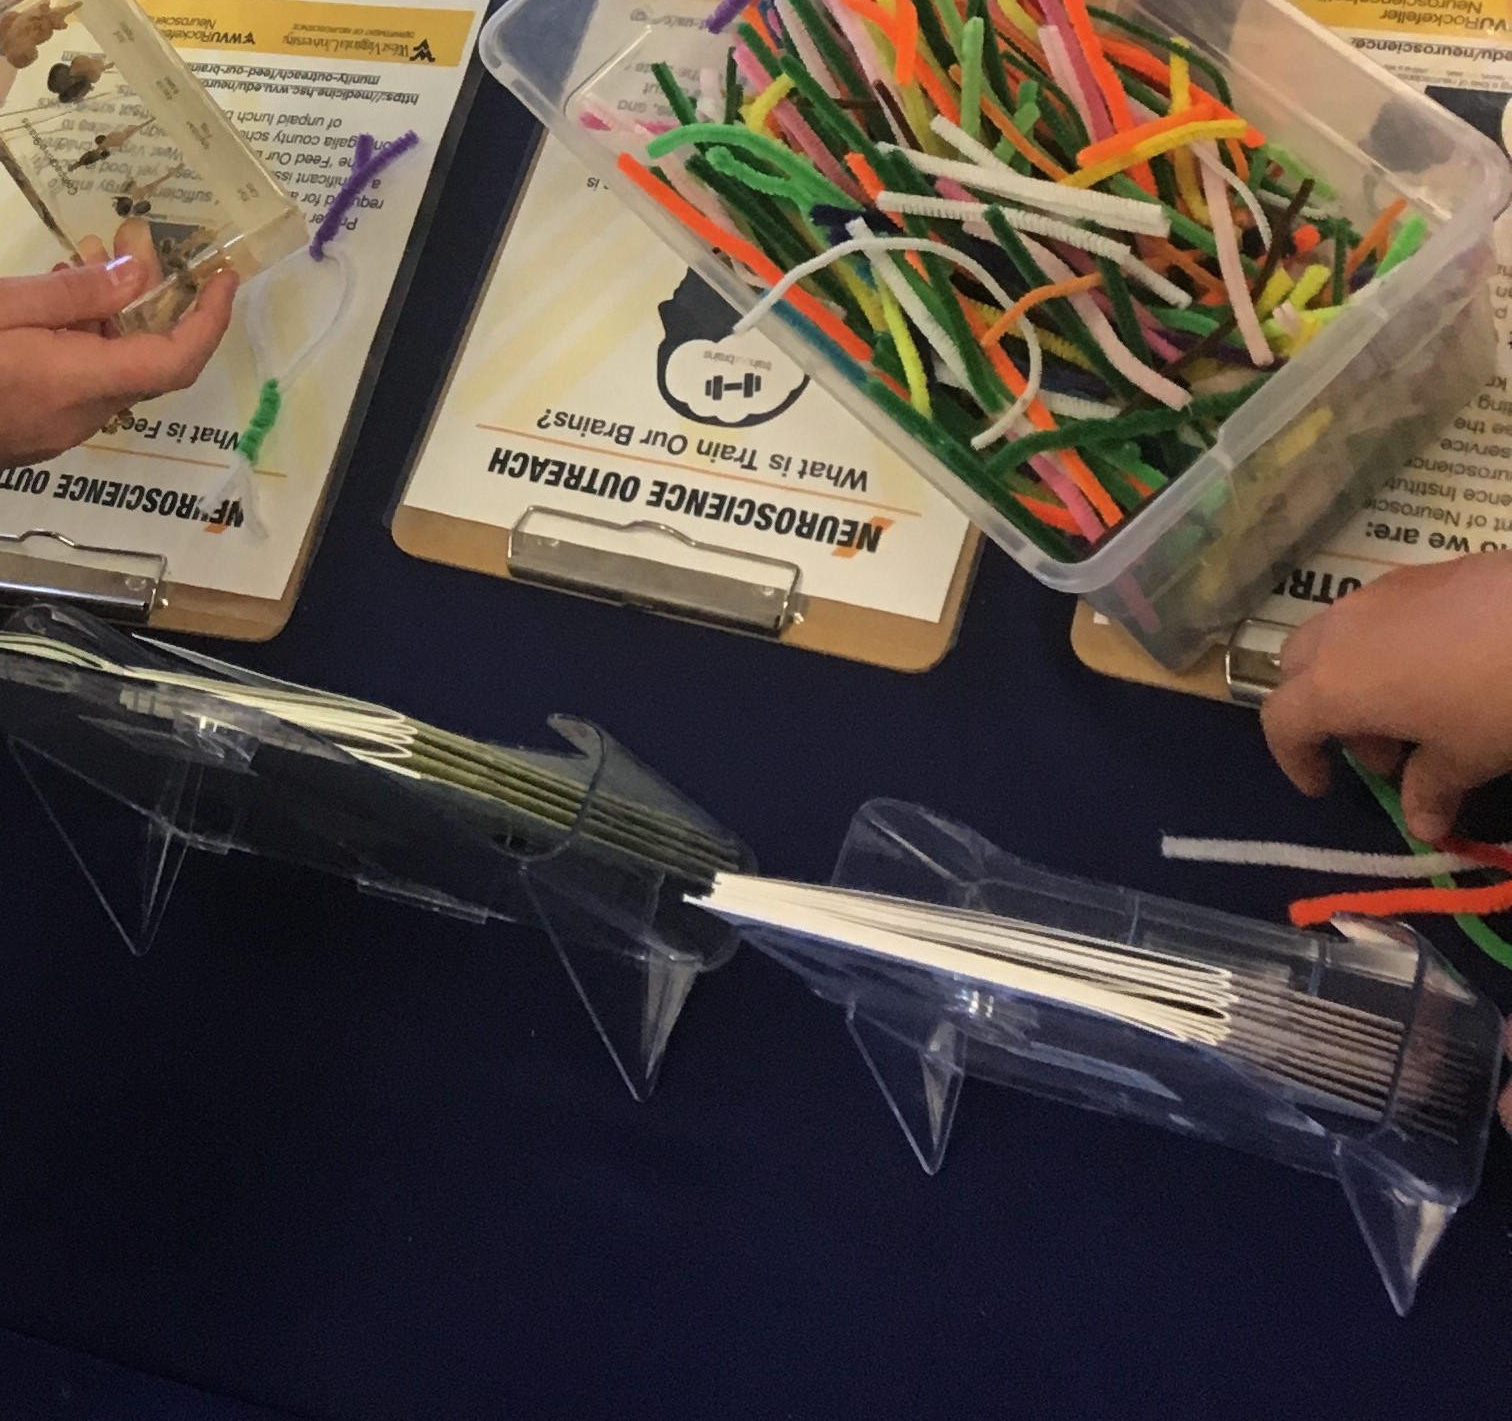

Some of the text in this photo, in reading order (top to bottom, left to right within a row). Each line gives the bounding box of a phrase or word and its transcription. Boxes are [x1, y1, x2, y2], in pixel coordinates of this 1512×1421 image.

[202, 79, 420, 106] https://medicine.hsc.wvu.edu/neuro
[237, 110, 342, 130] of unpaid lunch
[274, 129, 321, 147] county
[265, 150, 292, 165] Our
[302, 192, 322, 206] for
[325, 194, 384, 210] requd
[309, 213, 358, 231] Prer
[121, 416, 161, 438] Fee
[167, 423, 186, 443] is
[1453, 417, 1485, 435] the
[536, 408, 868, 492] What is Train Our Brains?
[487, 447, 882, 552] NEUROSCIENCE OUTREACH
[1383, 477, 1456, 502] Institut
[1468, 514, 1487, 530] of
[1365, 521, 1420, 546] are:
[1428, 532, 1469, 553] we
